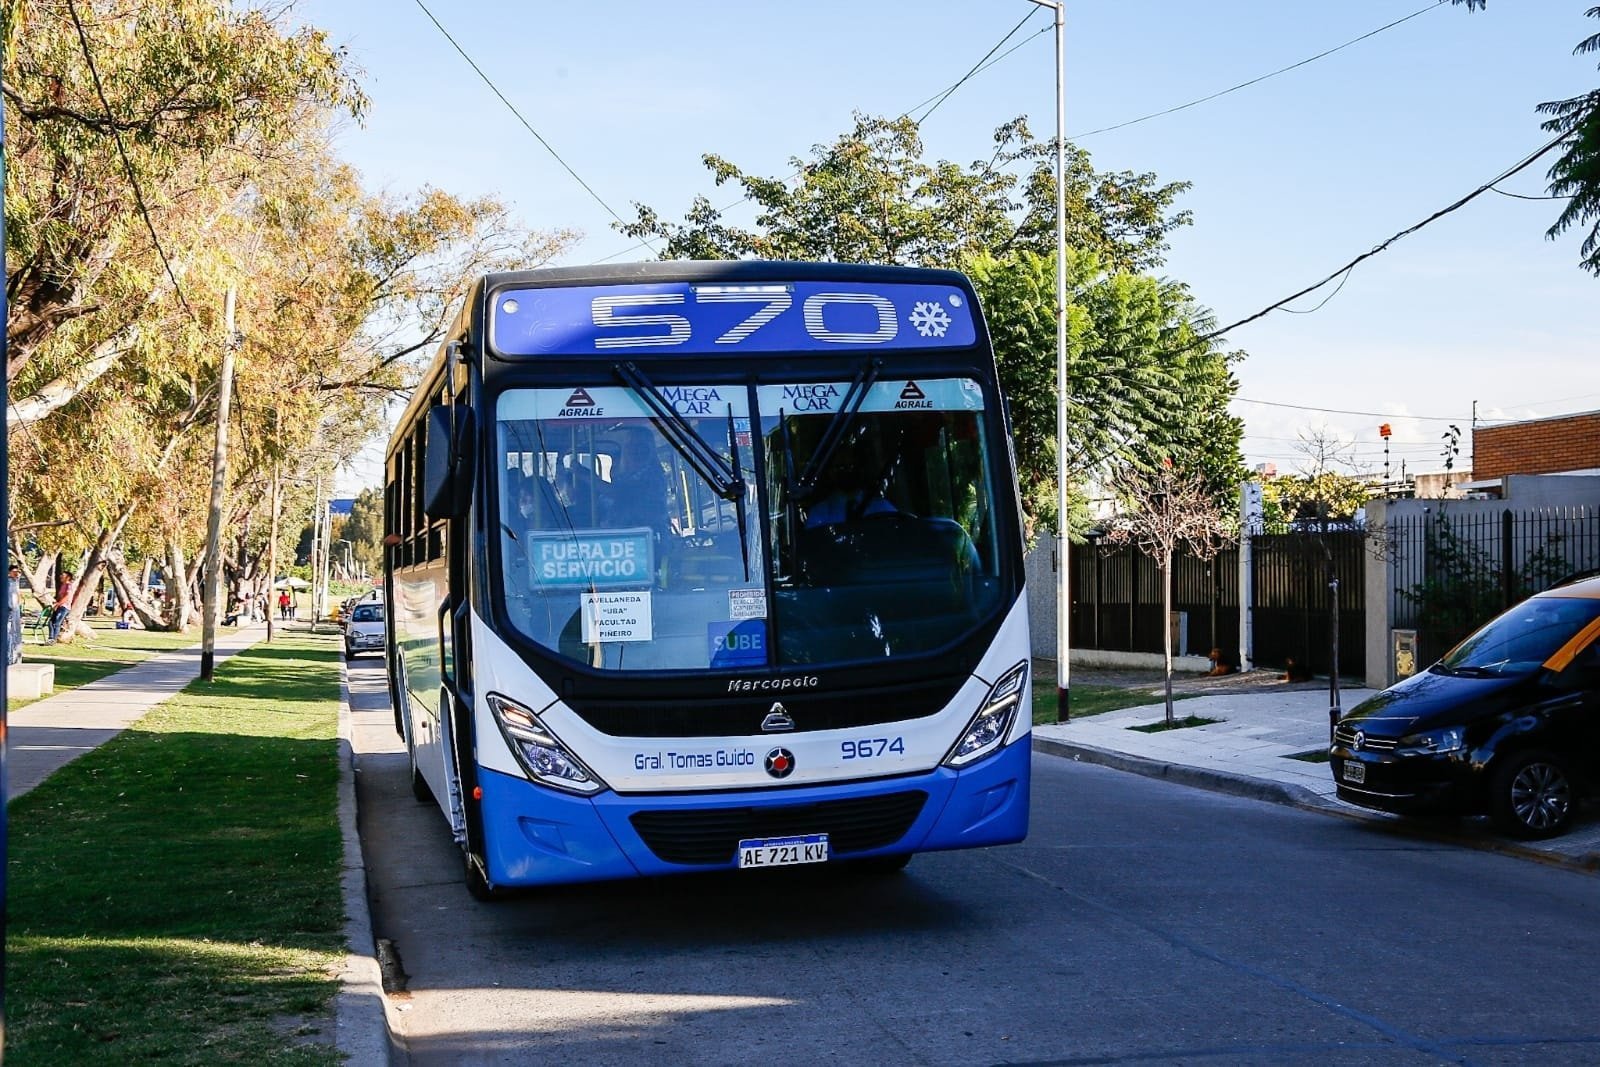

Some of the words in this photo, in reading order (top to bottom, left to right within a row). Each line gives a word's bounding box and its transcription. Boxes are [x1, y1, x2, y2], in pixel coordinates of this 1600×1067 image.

[591, 290, 899, 349] 570
[663, 386, 720, 402] MEGA
[782, 384, 840, 399] MEGA
[558, 407, 604, 417] AGRALE
[672, 400, 712, 414] CAR
[793, 397, 832, 411] CAR
[894, 401, 933, 409] AGRALE
[541, 543, 605, 561] FUERA
[610, 541, 636, 559] DE
[543, 559, 636, 579] SERVICIO
[588, 596, 641, 604] AVELLANEDA
[594, 618, 637, 626] FACULTAD
[713, 634, 762, 651] SUBE
[727, 676, 819, 692] Marcopolo
[841, 737, 905, 760] 9674
[635, 753, 665, 770] Gral.
[667, 750, 713, 769] Tomas
[716, 749, 754, 767] Guido
[744, 849, 764, 866] AE
[769, 846, 799, 863] 721
[805, 844, 824, 861] KV
